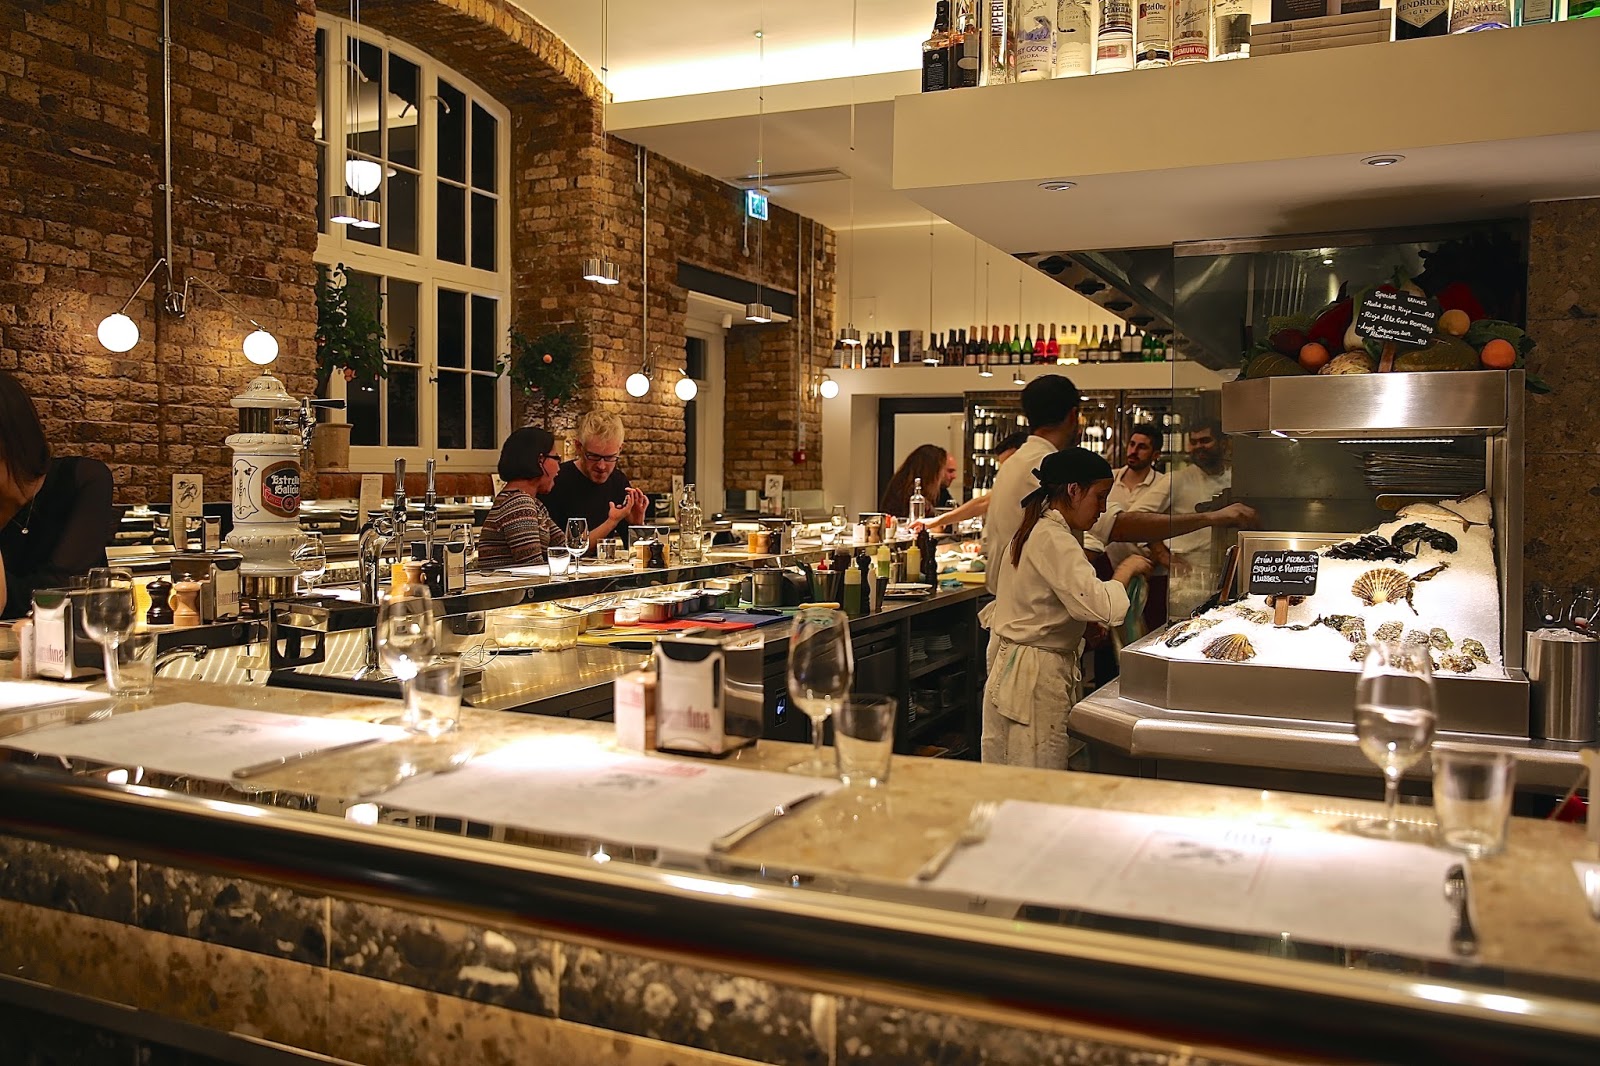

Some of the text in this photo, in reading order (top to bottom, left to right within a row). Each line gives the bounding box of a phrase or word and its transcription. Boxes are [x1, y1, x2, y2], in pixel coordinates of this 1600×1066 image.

[991, 0, 1004, 37] IMPERI
[1453, 9, 1471, 20] GIN
[1472, 4, 1504, 14] MARE
[1025, 46, 1048, 54] GOOSE
